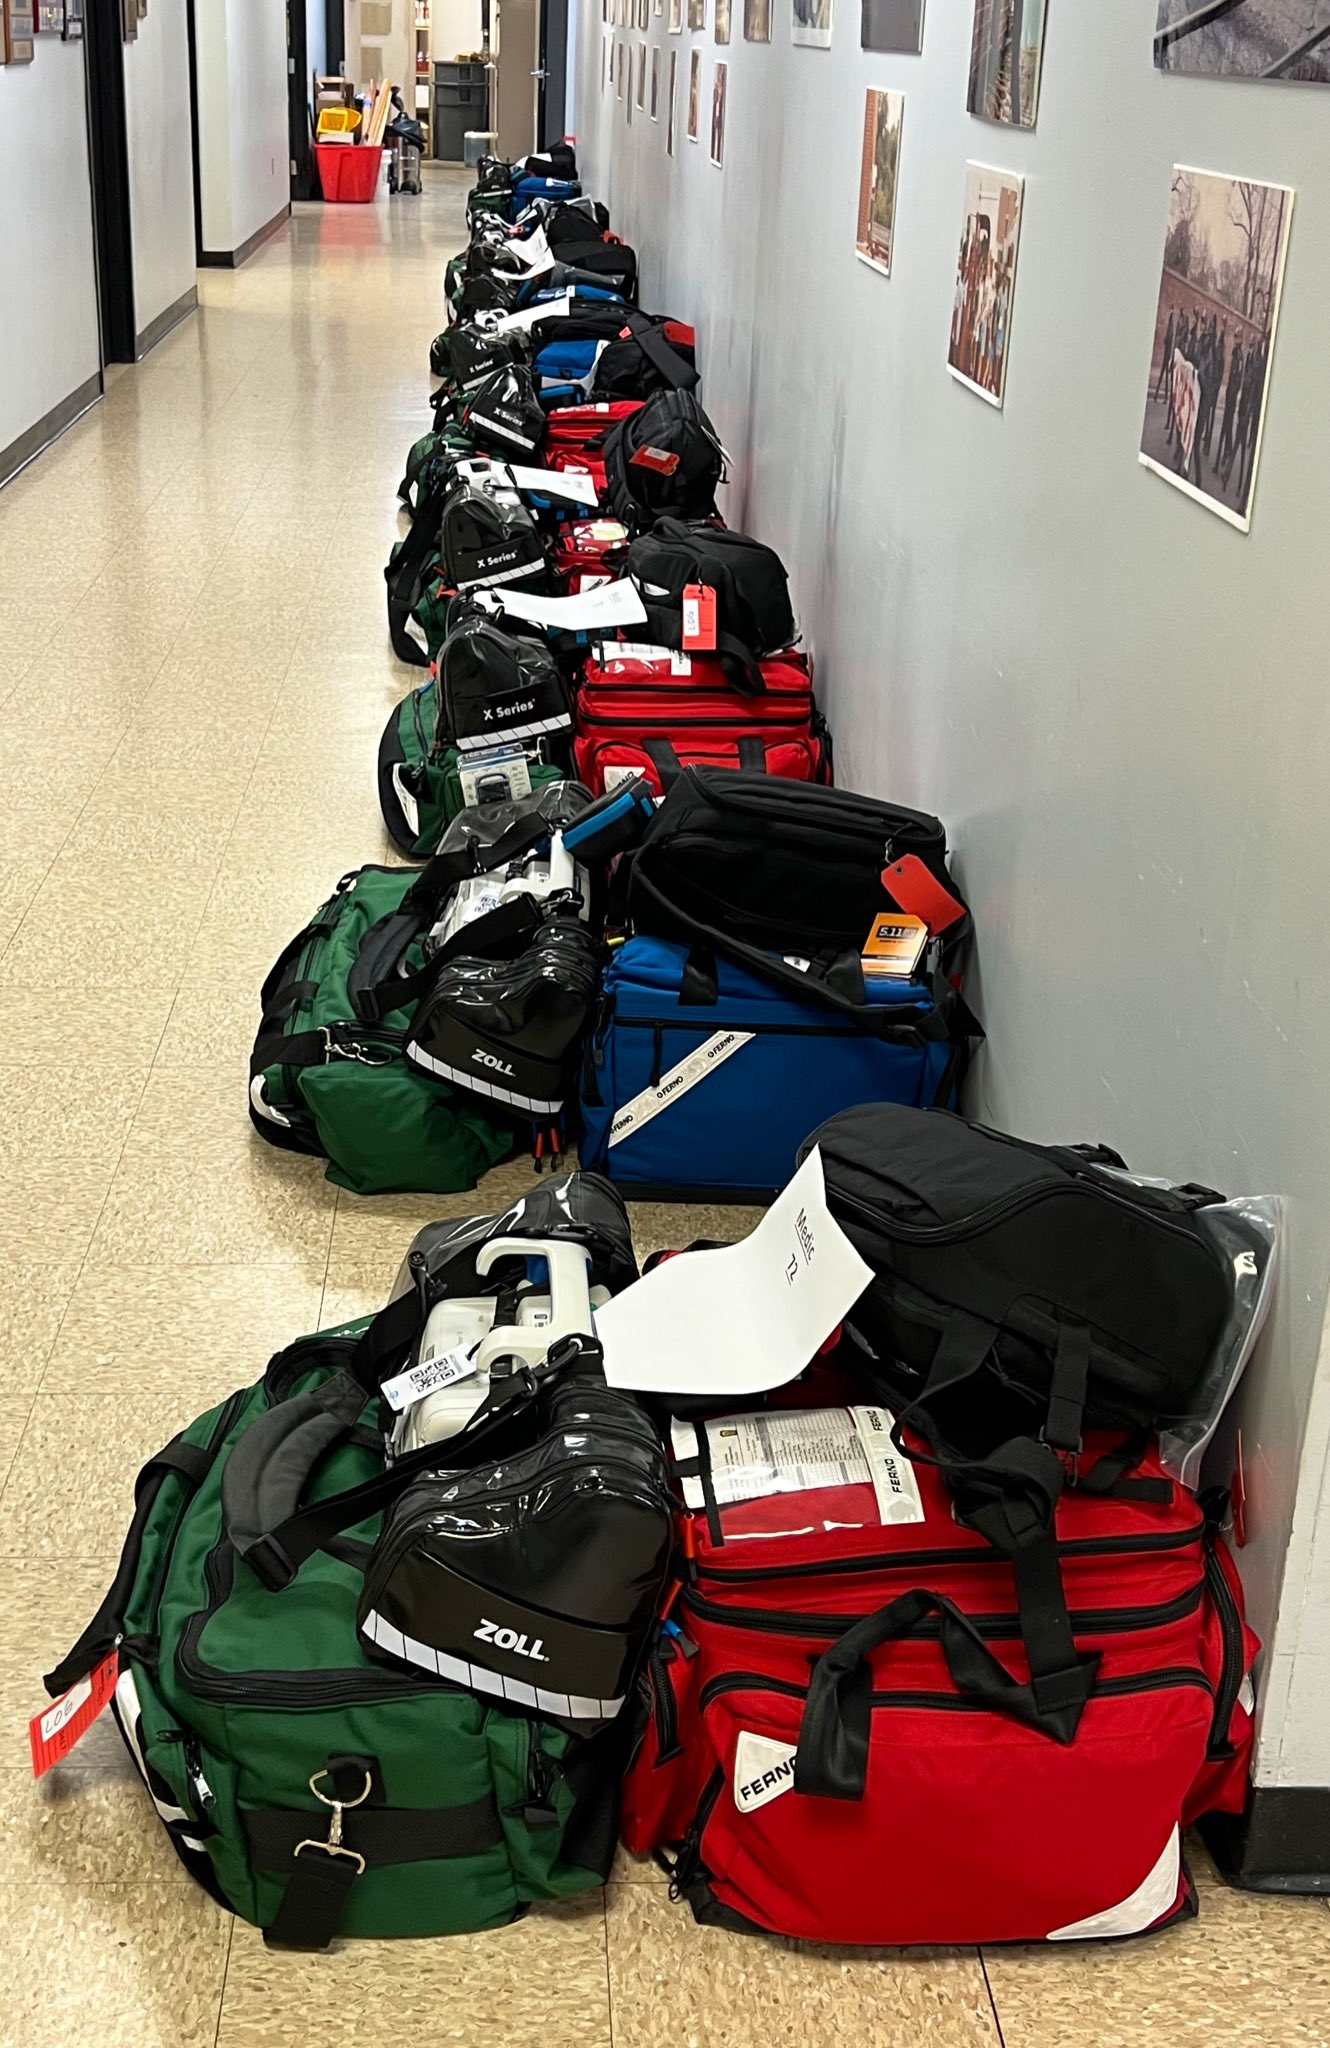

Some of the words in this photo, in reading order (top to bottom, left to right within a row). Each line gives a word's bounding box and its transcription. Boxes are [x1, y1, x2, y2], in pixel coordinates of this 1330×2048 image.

[493, 407, 501, 416] X
[477, 559, 486, 569] X
[487, 552, 517, 566] Series
[483, 709, 494, 721] X
[496, 701, 534, 718] Series
[878, 926, 903, 938] 5.11
[712, 1034, 735, 1055] FERNO
[471, 1048, 514, 1076] ZOLL
[661, 1075, 684, 1096] FERNO
[613, 1114, 634, 1132] FERNO
[796, 1207, 815, 1261] Medic
[884, 1458, 903, 1493] FERNO
[473, 1618, 545, 1661] ZOLL
[45, 1700, 74, 1734] LOG
